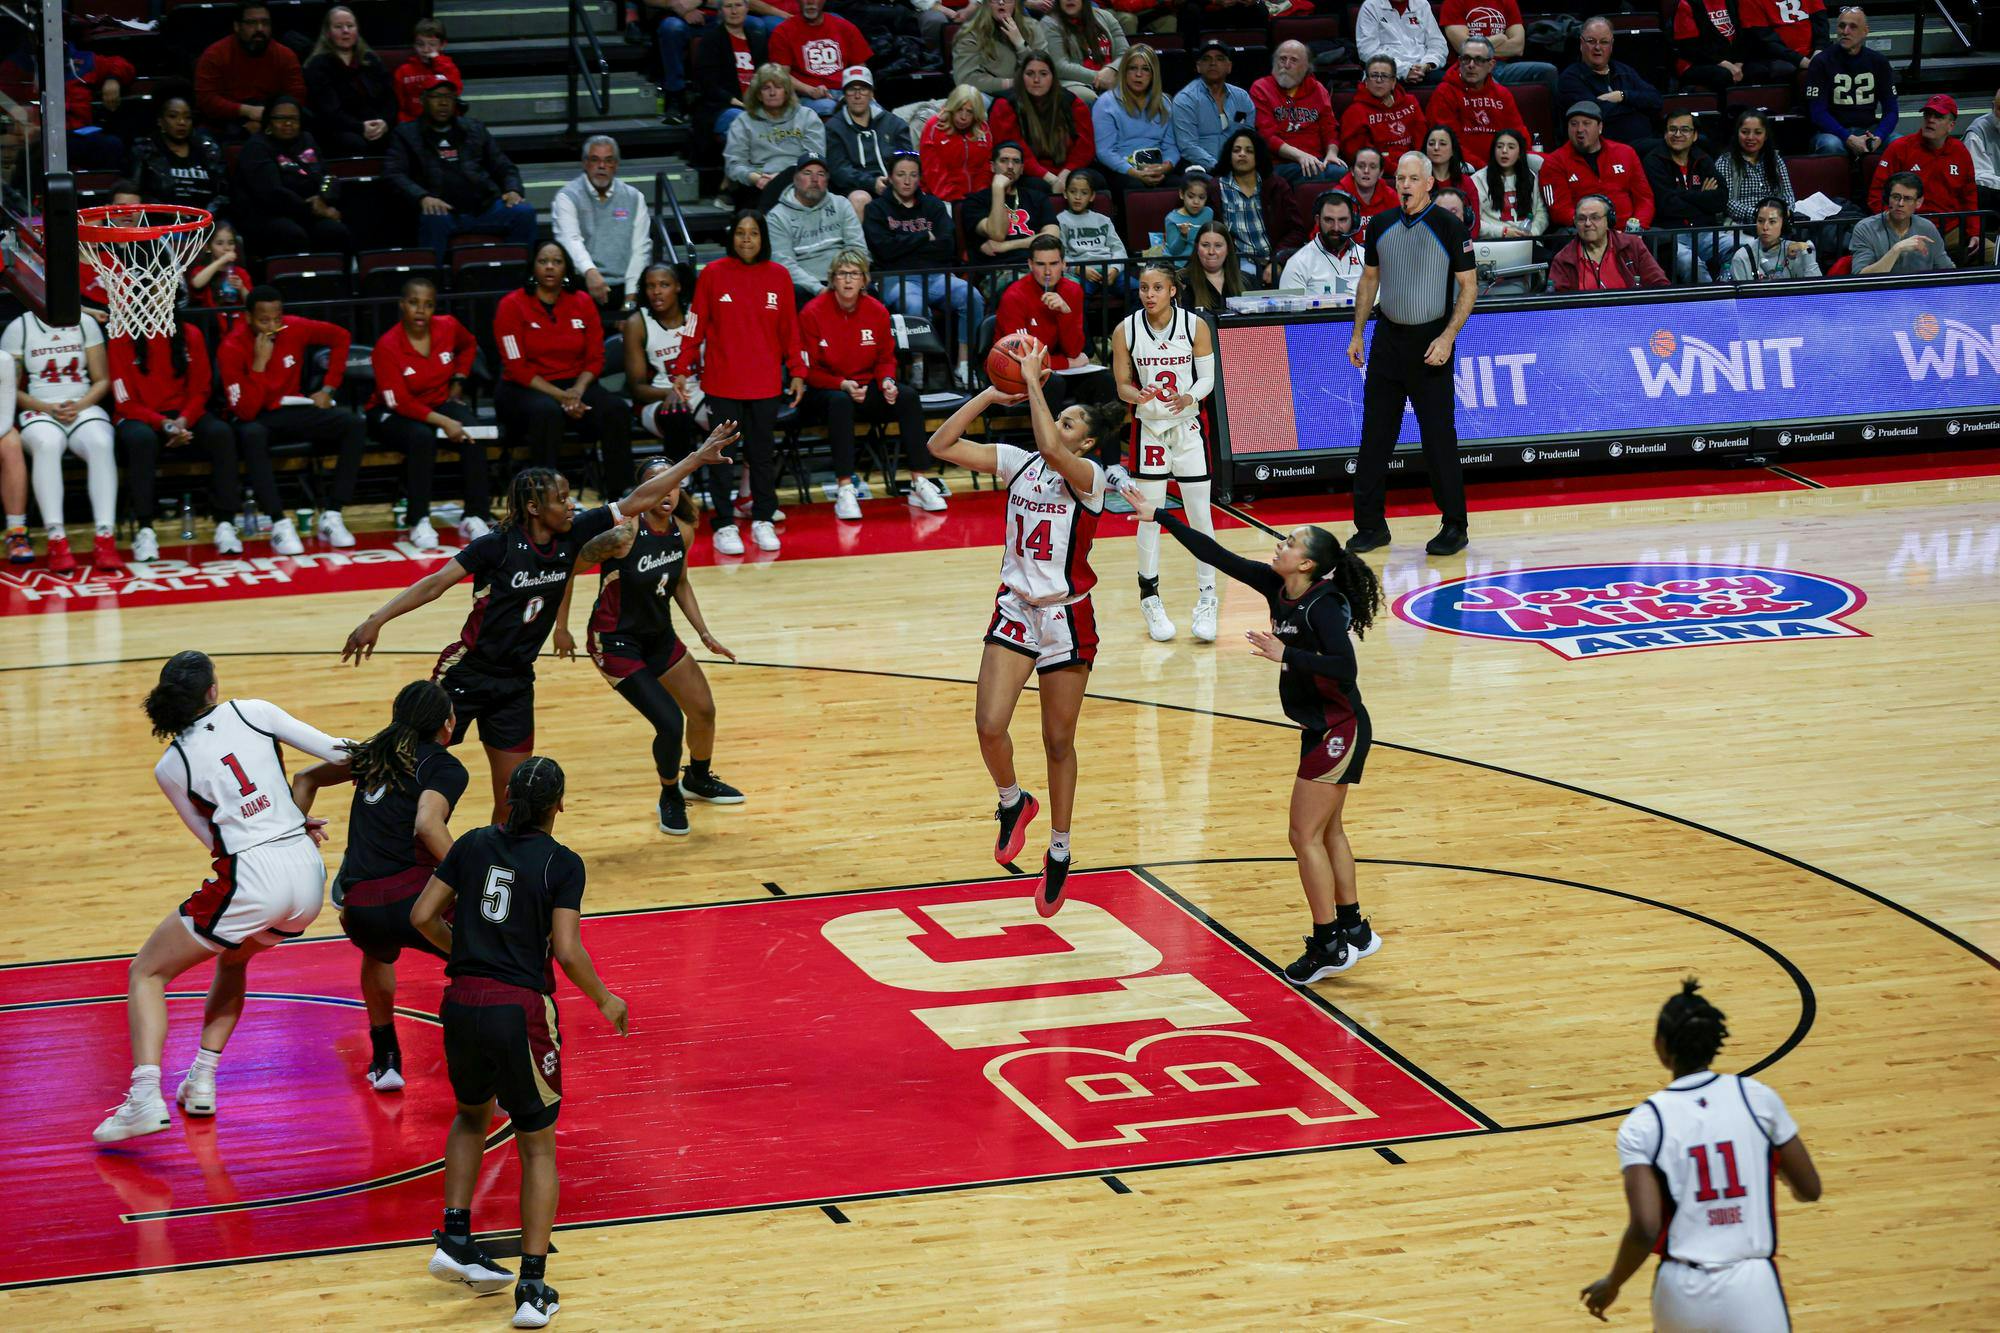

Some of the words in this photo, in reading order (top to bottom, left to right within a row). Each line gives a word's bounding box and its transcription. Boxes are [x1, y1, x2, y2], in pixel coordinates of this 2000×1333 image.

[1775, 0, 1809, 23] R
[734, 52, 755, 70] R
[1806, 86, 1819, 97] 22
[1833, 72, 1875, 105] 22
[1612, 164, 1625, 174] R
[1949, 164, 1959, 175] R
[1008, 208, 1035, 237] R
[766, 292, 778, 305] R
[571, 319, 585, 329] R
[890, 325, 932, 337] Prdential
[860, 329, 874, 341] R
[1136, 354, 1191, 366] RUTGERS
[1893, 319, 2000, 381] WN
[40, 357, 83, 383] 44
[1629, 334, 1804, 398] WNIT
[1154, 371, 1179, 403] 3
[1453, 353, 1537, 408] NIT
[1878, 426, 1919, 437] Prudential
[1962, 421, 2000, 432] Prudentia
[1708, 437, 1749, 449] Prudential
[1794, 431, 1835, 443] Prudential
[1144, 445, 1165, 466] R
[1538, 448, 1580, 460] Prudential
[1625, 443, 1667, 454] Prudential
[1459, 453, 1493, 465] udential
[1272, 465, 1316, 478] Prudential
[1010, 494, 1067, 514] RUTGERS
[1015, 514, 1053, 561] 14
[637, 550, 684, 573] Charleston
[21, 569, 292, 601] HEALTH
[511, 570, 567, 589] Charleston
[1455, 575, 1780, 611] Jersey
[1507, 593, 1807, 632] Mike's
[1575, 622, 1818, 655] ARENA
[220, 752, 258, 797] 1
[240, 794, 271, 819] ADAMS
[480, 865, 516, 924] 5
[1688, 1140, 1747, 1202] 11
